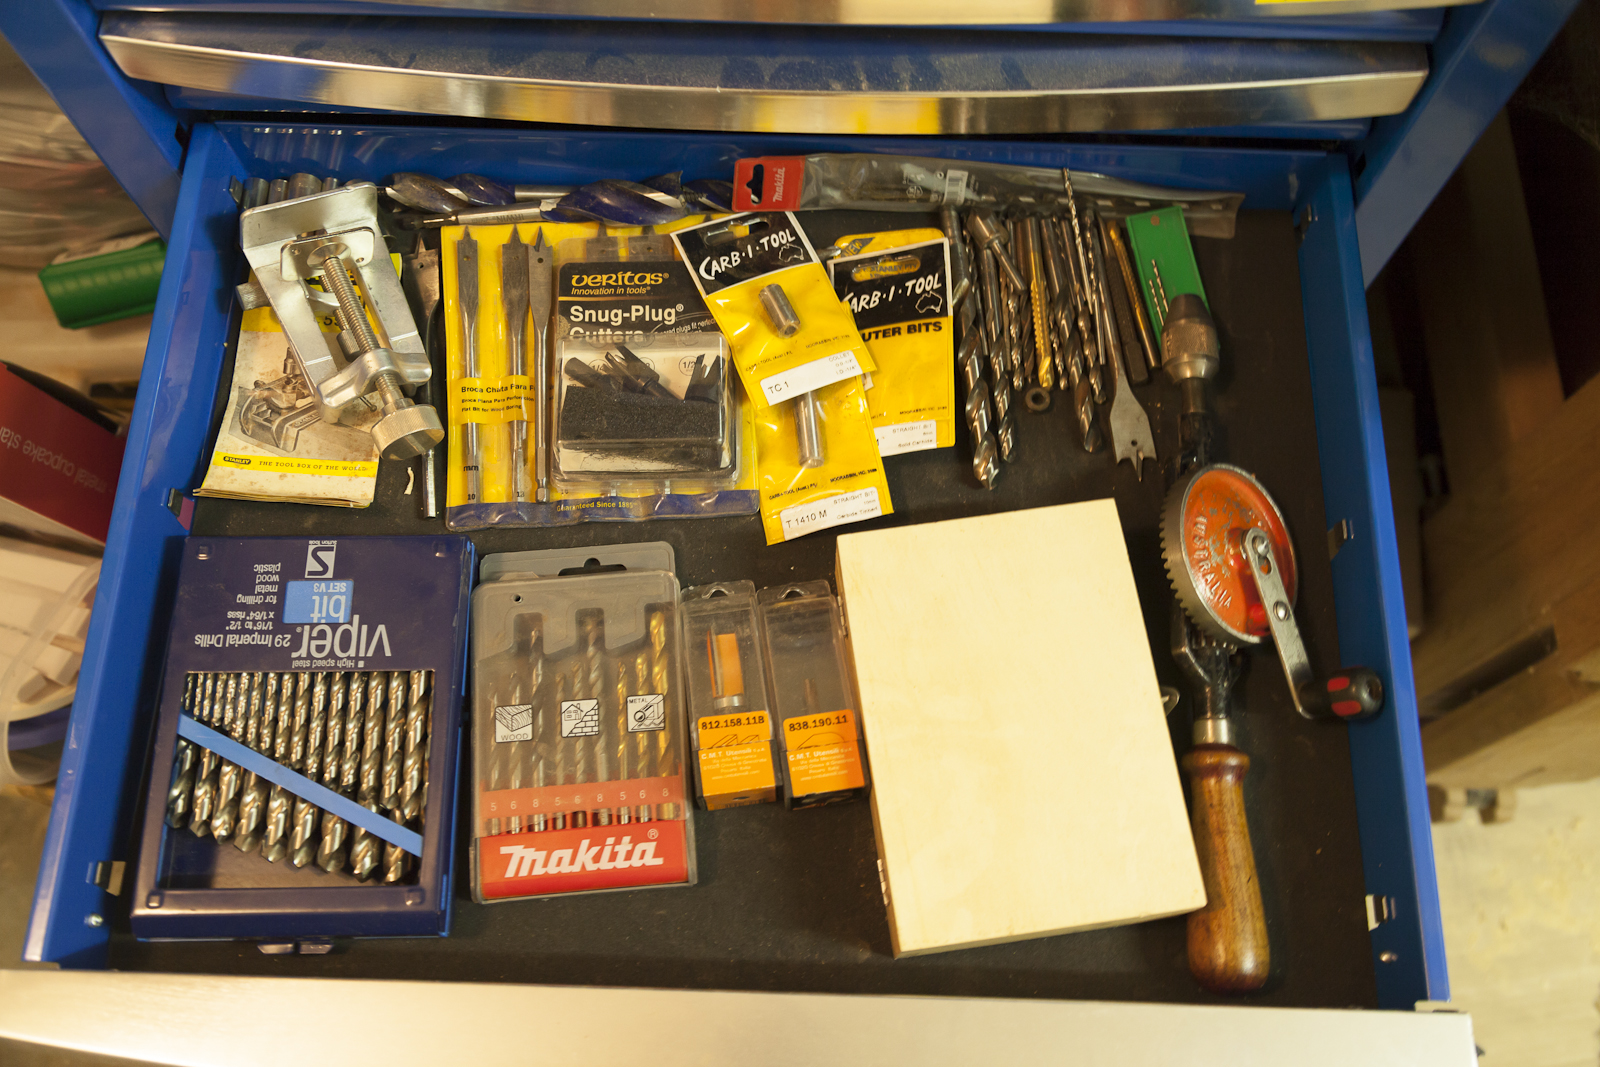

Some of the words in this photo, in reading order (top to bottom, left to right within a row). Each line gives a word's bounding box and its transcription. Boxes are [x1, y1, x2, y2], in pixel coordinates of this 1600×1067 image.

[571, 287, 615, 296] Innovation
[616, 287, 625, 295] in
[569, 304, 676, 327] Snug-Plug
[862, 326, 902, 343] UTER
[907, 321, 943, 334] BITS
[461, 386, 484, 394] Broca
[486, 386, 508, 394] Chata
[768, 384, 782, 394] TC
[22, 439, 75, 477] cupcake
[223, 456, 252, 465] STANLEY
[833, 493, 864, 505] STRAIGHT
[556, 502, 594, 512] Guaranteed
[596, 500, 616, 508] Since
[786, 520, 792, 528] T
[795, 512, 817, 526] 1410
[818, 510, 828, 518] M
[254, 562, 282, 574] plastic
[256, 574, 280, 584] wood
[255, 584, 278, 594] metal
[313, 582, 327, 592] V3
[328, 582, 347, 592] SET
[236, 594, 266, 605] drilling
[266, 595, 278, 604] for
[310, 595, 347, 623] bit
[194, 634, 223, 648] Drills
[225, 632, 273, 648] Imperial
[274, 634, 291, 647] 29
[291, 615, 392, 658] viper
[292, 659, 312, 668] steel
[312, 658, 336, 668] speed
[337, 658, 355, 668] High
[628, 697, 648, 705] METAL
[788, 714, 849, 732] 838.190.11
[500, 733, 529, 742] WOOD
[490, 802, 497, 811] 5
[510, 801, 517, 810] 6
[532, 799, 540, 808] 8
[554, 797, 561, 806] 5
[574, 796, 581, 804] 6
[596, 794, 604, 802] 8
[620, 792, 626, 800] 5
[639, 790, 646, 798] 6
[662, 788, 669, 797] 8
